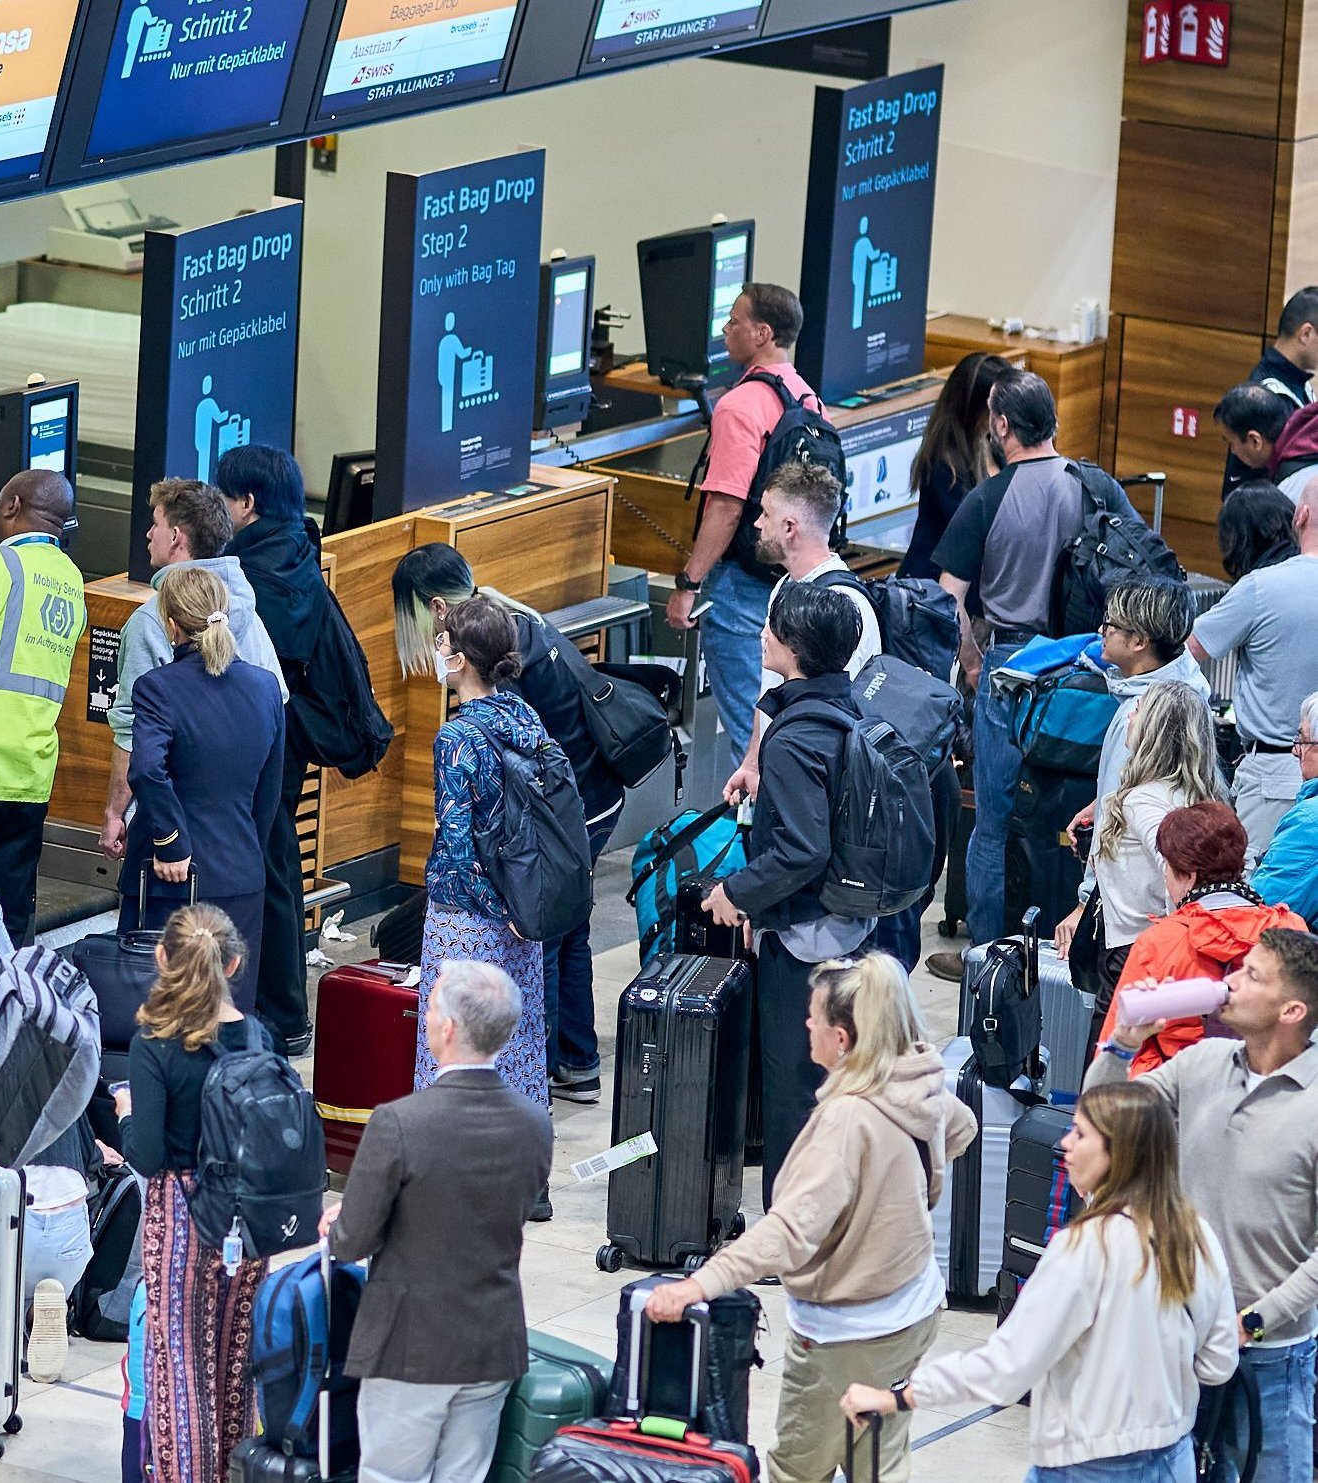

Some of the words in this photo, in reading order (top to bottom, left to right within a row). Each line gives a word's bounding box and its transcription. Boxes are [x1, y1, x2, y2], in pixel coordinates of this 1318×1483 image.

[178, 10, 238, 43] Schritt
[238, 6, 253, 31] 2
[390, 1, 434, 21] Baggage
[450, 21, 479, 34] brussels
[633, 9, 661, 25] SWISS
[350, 39, 392, 59] Austrian
[635, 30, 659, 45] STAR
[660, 19, 707, 39] ALLIANCE
[170, 62, 192, 80] Nur
[194, 55, 214, 75] mit
[217, 41, 287, 73] Gepäcklabel
[365, 62, 395, 80] SWISS
[367, 84, 394, 101] STAR
[395, 73, 445, 95] ALLIANCE
[848, 104, 874, 132] Fast
[876, 98, 901, 126] Bag
[904, 90, 937, 117] Drop
[844, 135, 884, 168] Schritt
[885, 131, 896, 154] 2
[423, 194, 455, 221] Fast
[459, 185, 490, 215] Bag
[494, 176, 536, 205] Drop
[842, 183, 857, 201] Nur
[859, 176, 874, 195] mit
[874, 162, 929, 191] Gepäcklabel
[182, 250, 214, 283] Fast
[217, 243, 248, 273] Bag
[252, 232, 293, 261] Drop
[421, 232, 454, 259] Step
[458, 224, 469, 249] 2
[419, 275, 442, 298] Only
[445, 267, 469, 290] with
[472, 263, 492, 285] Bag
[496, 258, 516, 279] Tag
[180, 284, 229, 321] Schritt
[232, 279, 243, 305] 2
[178, 340, 196, 360] Nur
[199, 331, 216, 353] mit
[219, 311, 287, 347] Gepäcklabel
[33, 573, 63, 595] Mobility
[63, 582, 84, 600] Servic
[92, 628, 121, 640] Gepäcklabe
[92, 638, 106, 646] nach
[105, 640, 119, 648] oben
